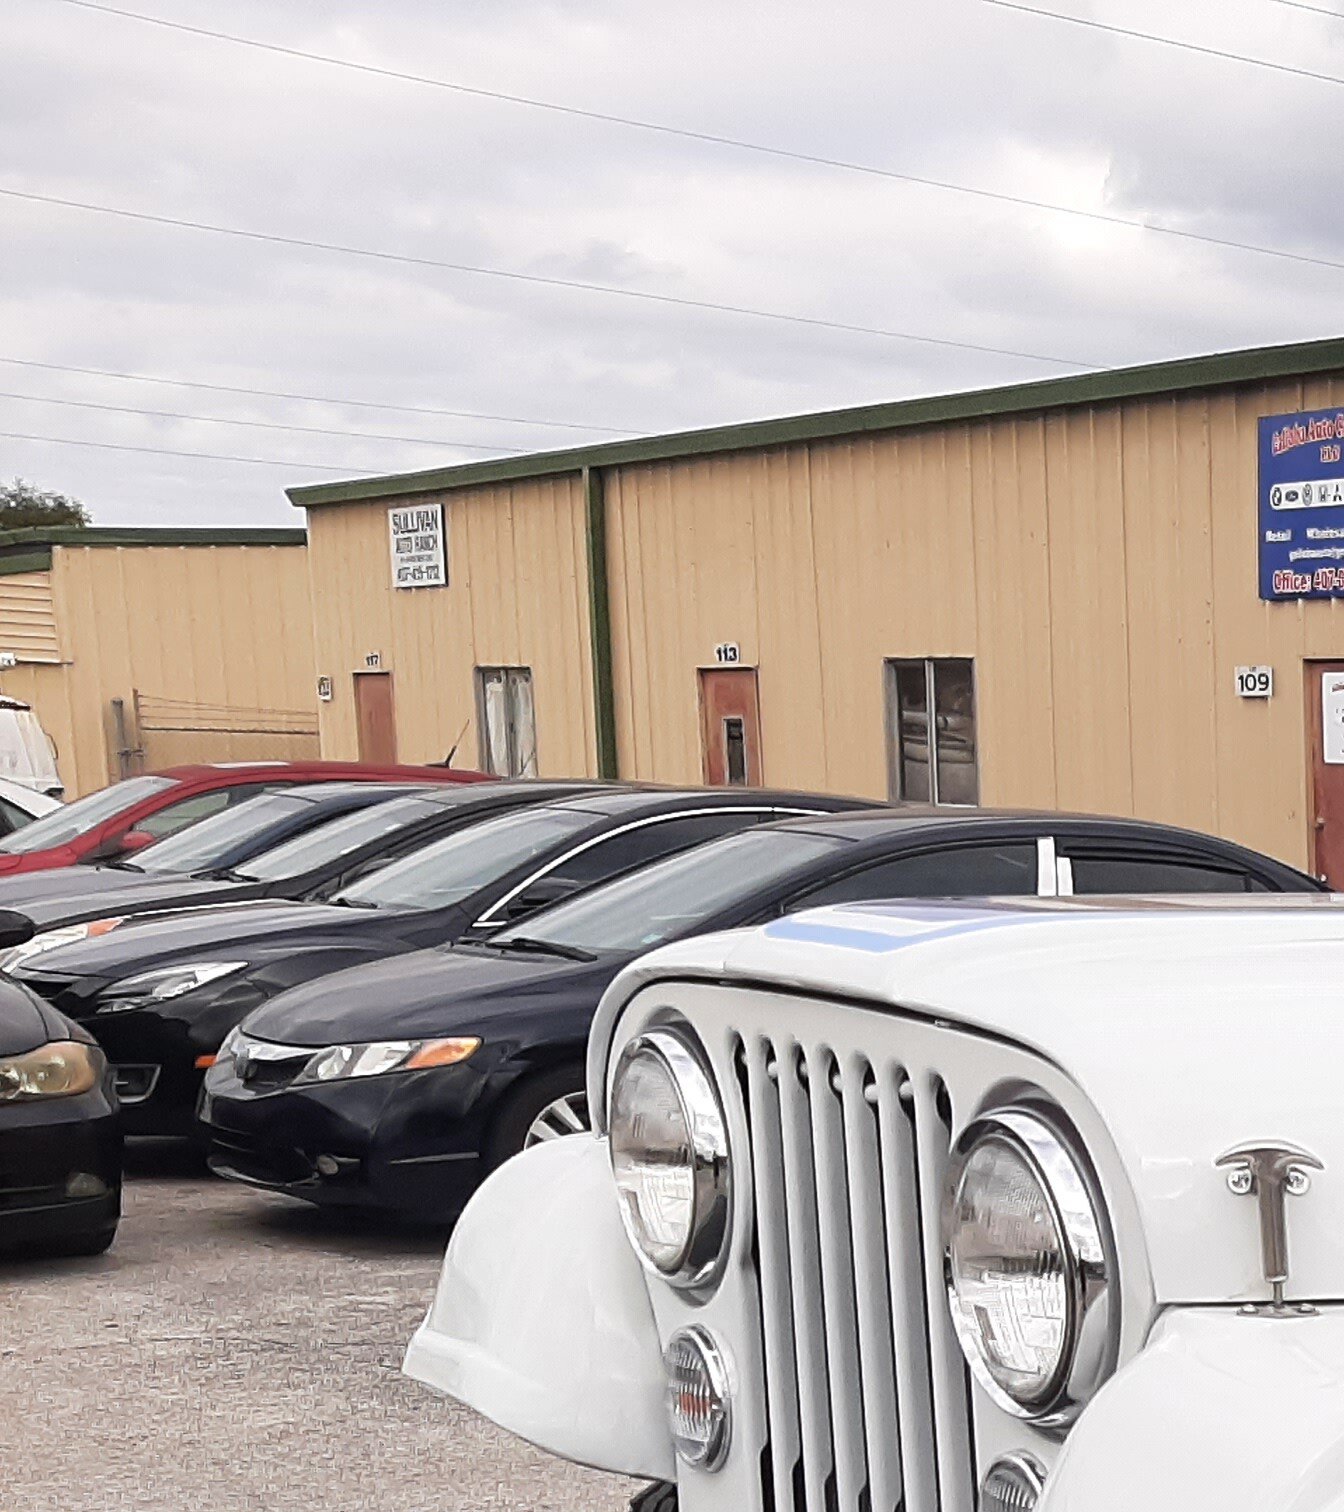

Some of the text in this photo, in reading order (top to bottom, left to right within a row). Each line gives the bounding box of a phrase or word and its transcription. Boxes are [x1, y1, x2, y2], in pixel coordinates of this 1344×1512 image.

[392, 509, 438, 536] SULLIVAN
[716, 647, 737, 662] 113
[1238, 673, 1270, 692] 109
